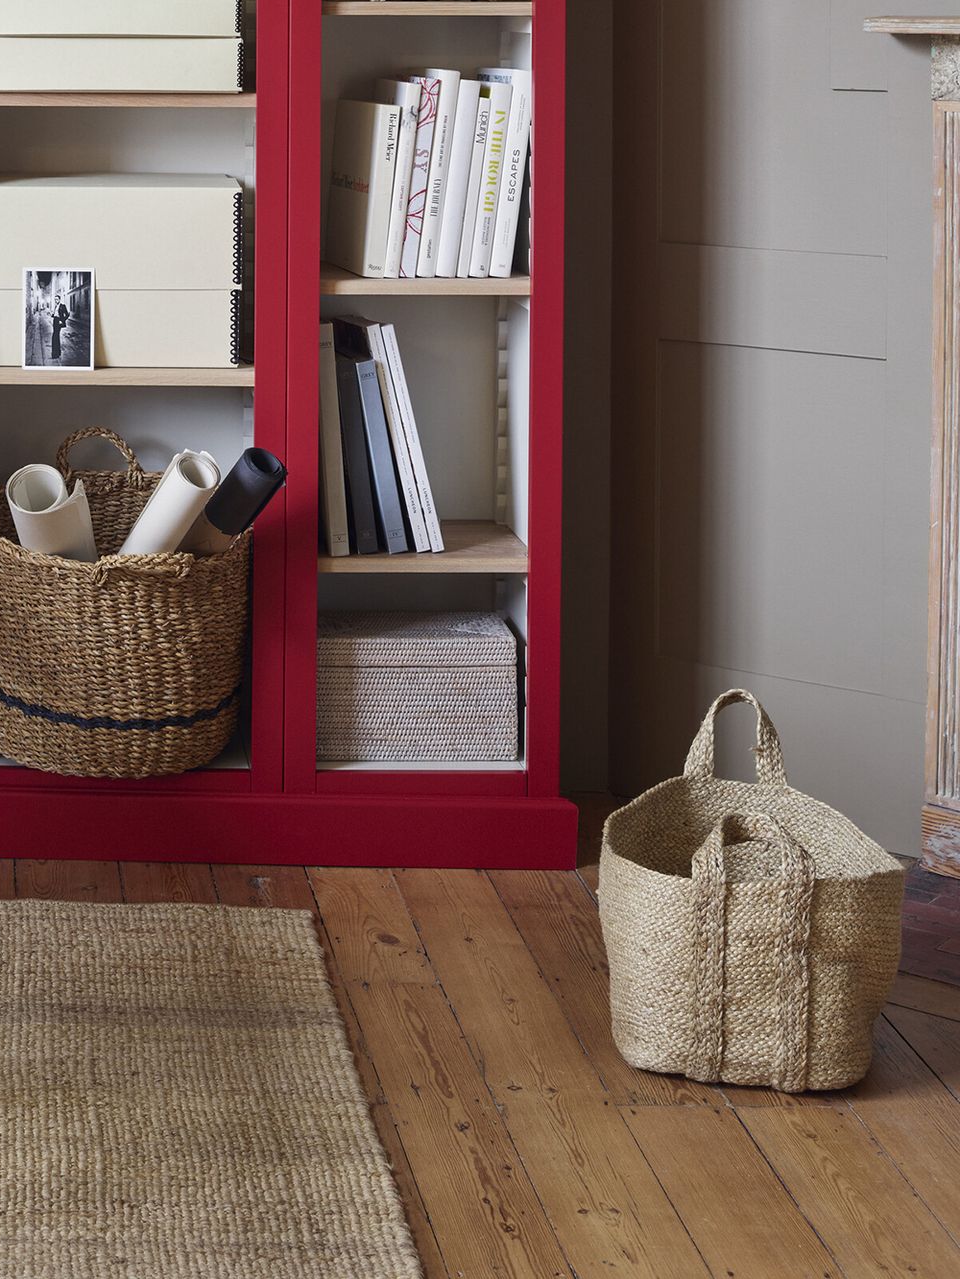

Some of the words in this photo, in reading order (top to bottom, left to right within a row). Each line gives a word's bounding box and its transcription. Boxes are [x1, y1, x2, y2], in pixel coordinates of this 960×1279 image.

[387, 113, 397, 141] Richard
[475, 110, 489, 144] Munich
[385, 142, 395, 162] Meier
[507, 149, 521, 202] ESCAPES
[432, 177, 442, 205] JOURNEY
[407, 487, 417, 514] LUNCHEON
[422, 487, 432, 514] LUNCHEON
